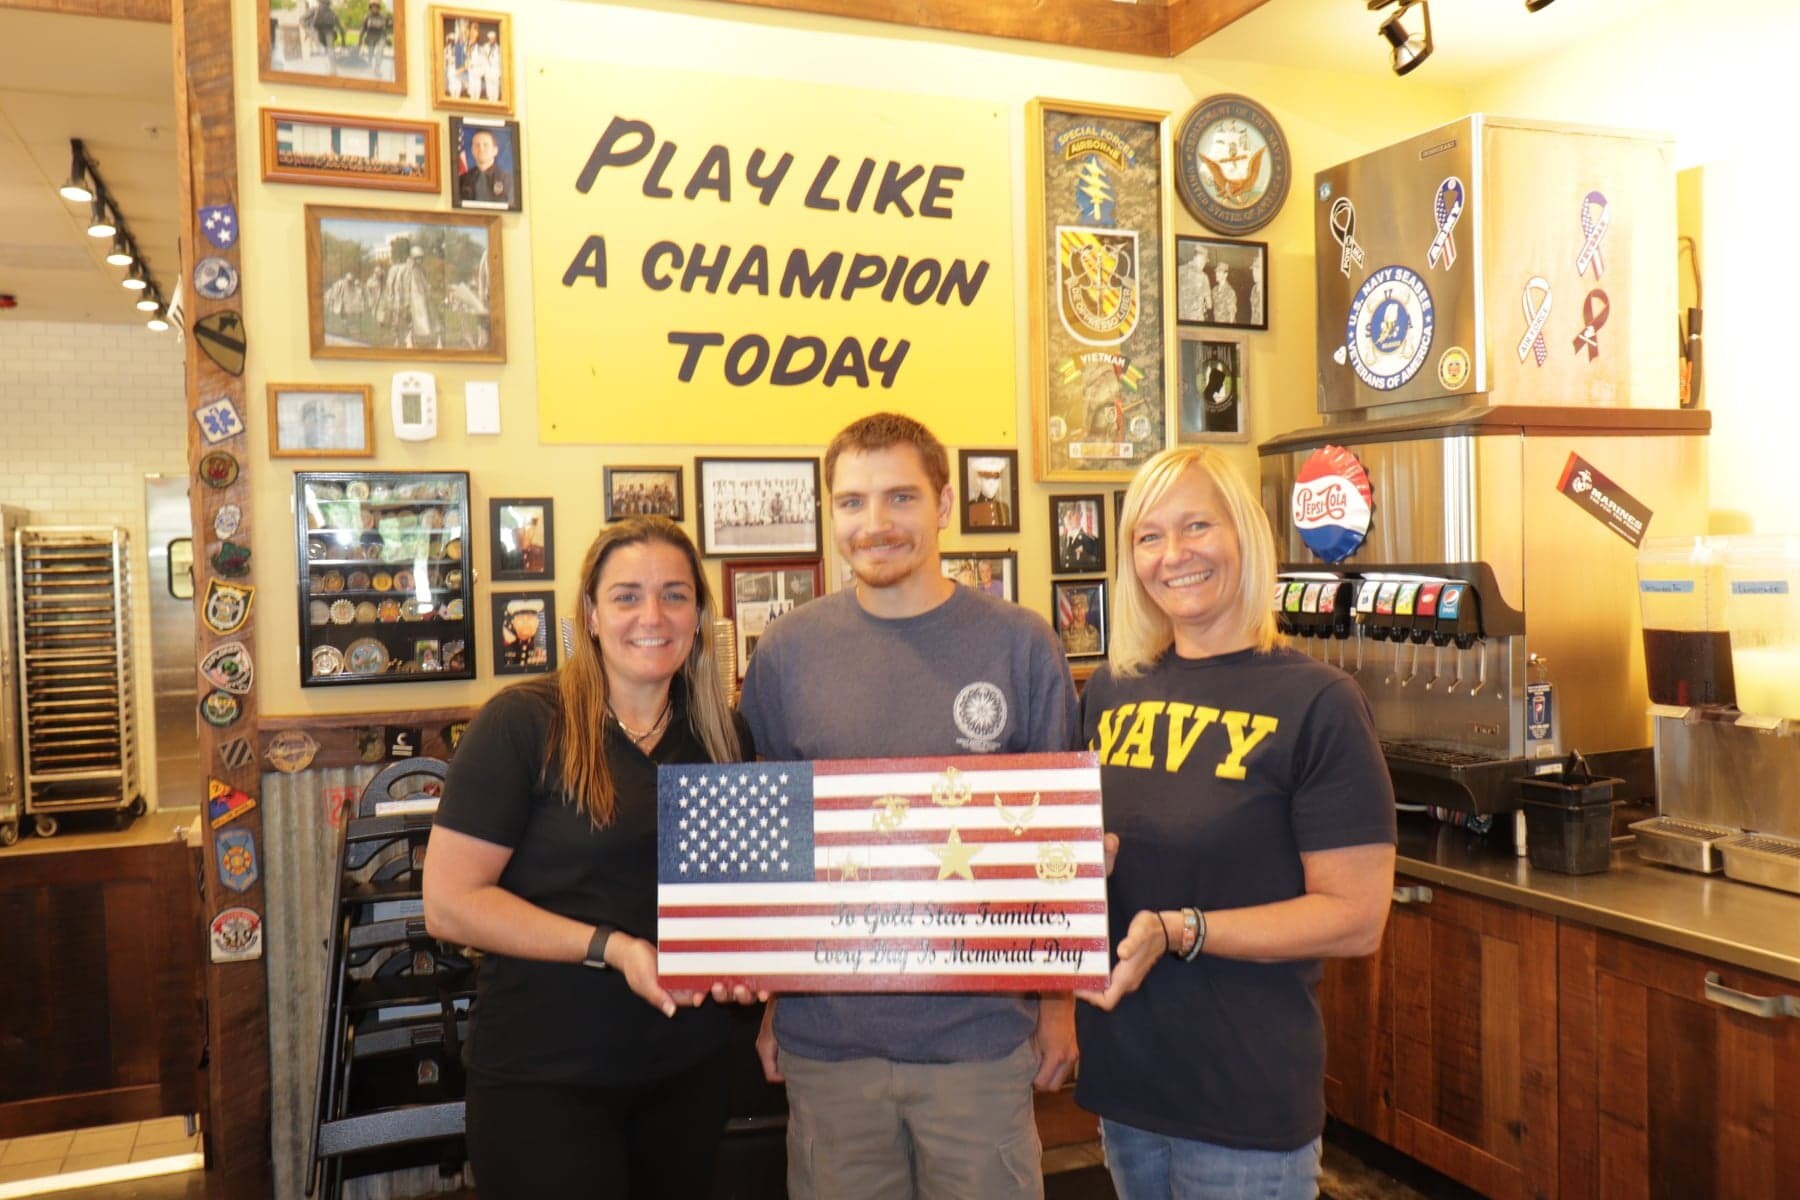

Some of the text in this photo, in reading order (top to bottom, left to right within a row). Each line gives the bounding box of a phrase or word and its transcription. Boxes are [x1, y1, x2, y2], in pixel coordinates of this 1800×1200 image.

[1058, 126, 1135, 159] SPECIAL FORCES
[1071, 139, 1120, 161] AIRBORNE
[575, 116, 965, 219] PLAY LIKE
[562, 235, 990, 306] A CHAMPION
[1348, 269, 1432, 326] U.S. NAVY SEABEE
[667, 331, 911, 389] TODAY
[1079, 352, 1126, 367] VIETNAM
[1348, 340, 1386, 389] VETERANS
[1386, 374, 1402, 389] OF
[1401, 325, 1433, 383] AMERICA
[1590, 486, 1643, 531] MARINES
[831, 899, 1071, 934] To Gold Star Families,
[814, 937, 1084, 975] Every Day Is Memorial Day
